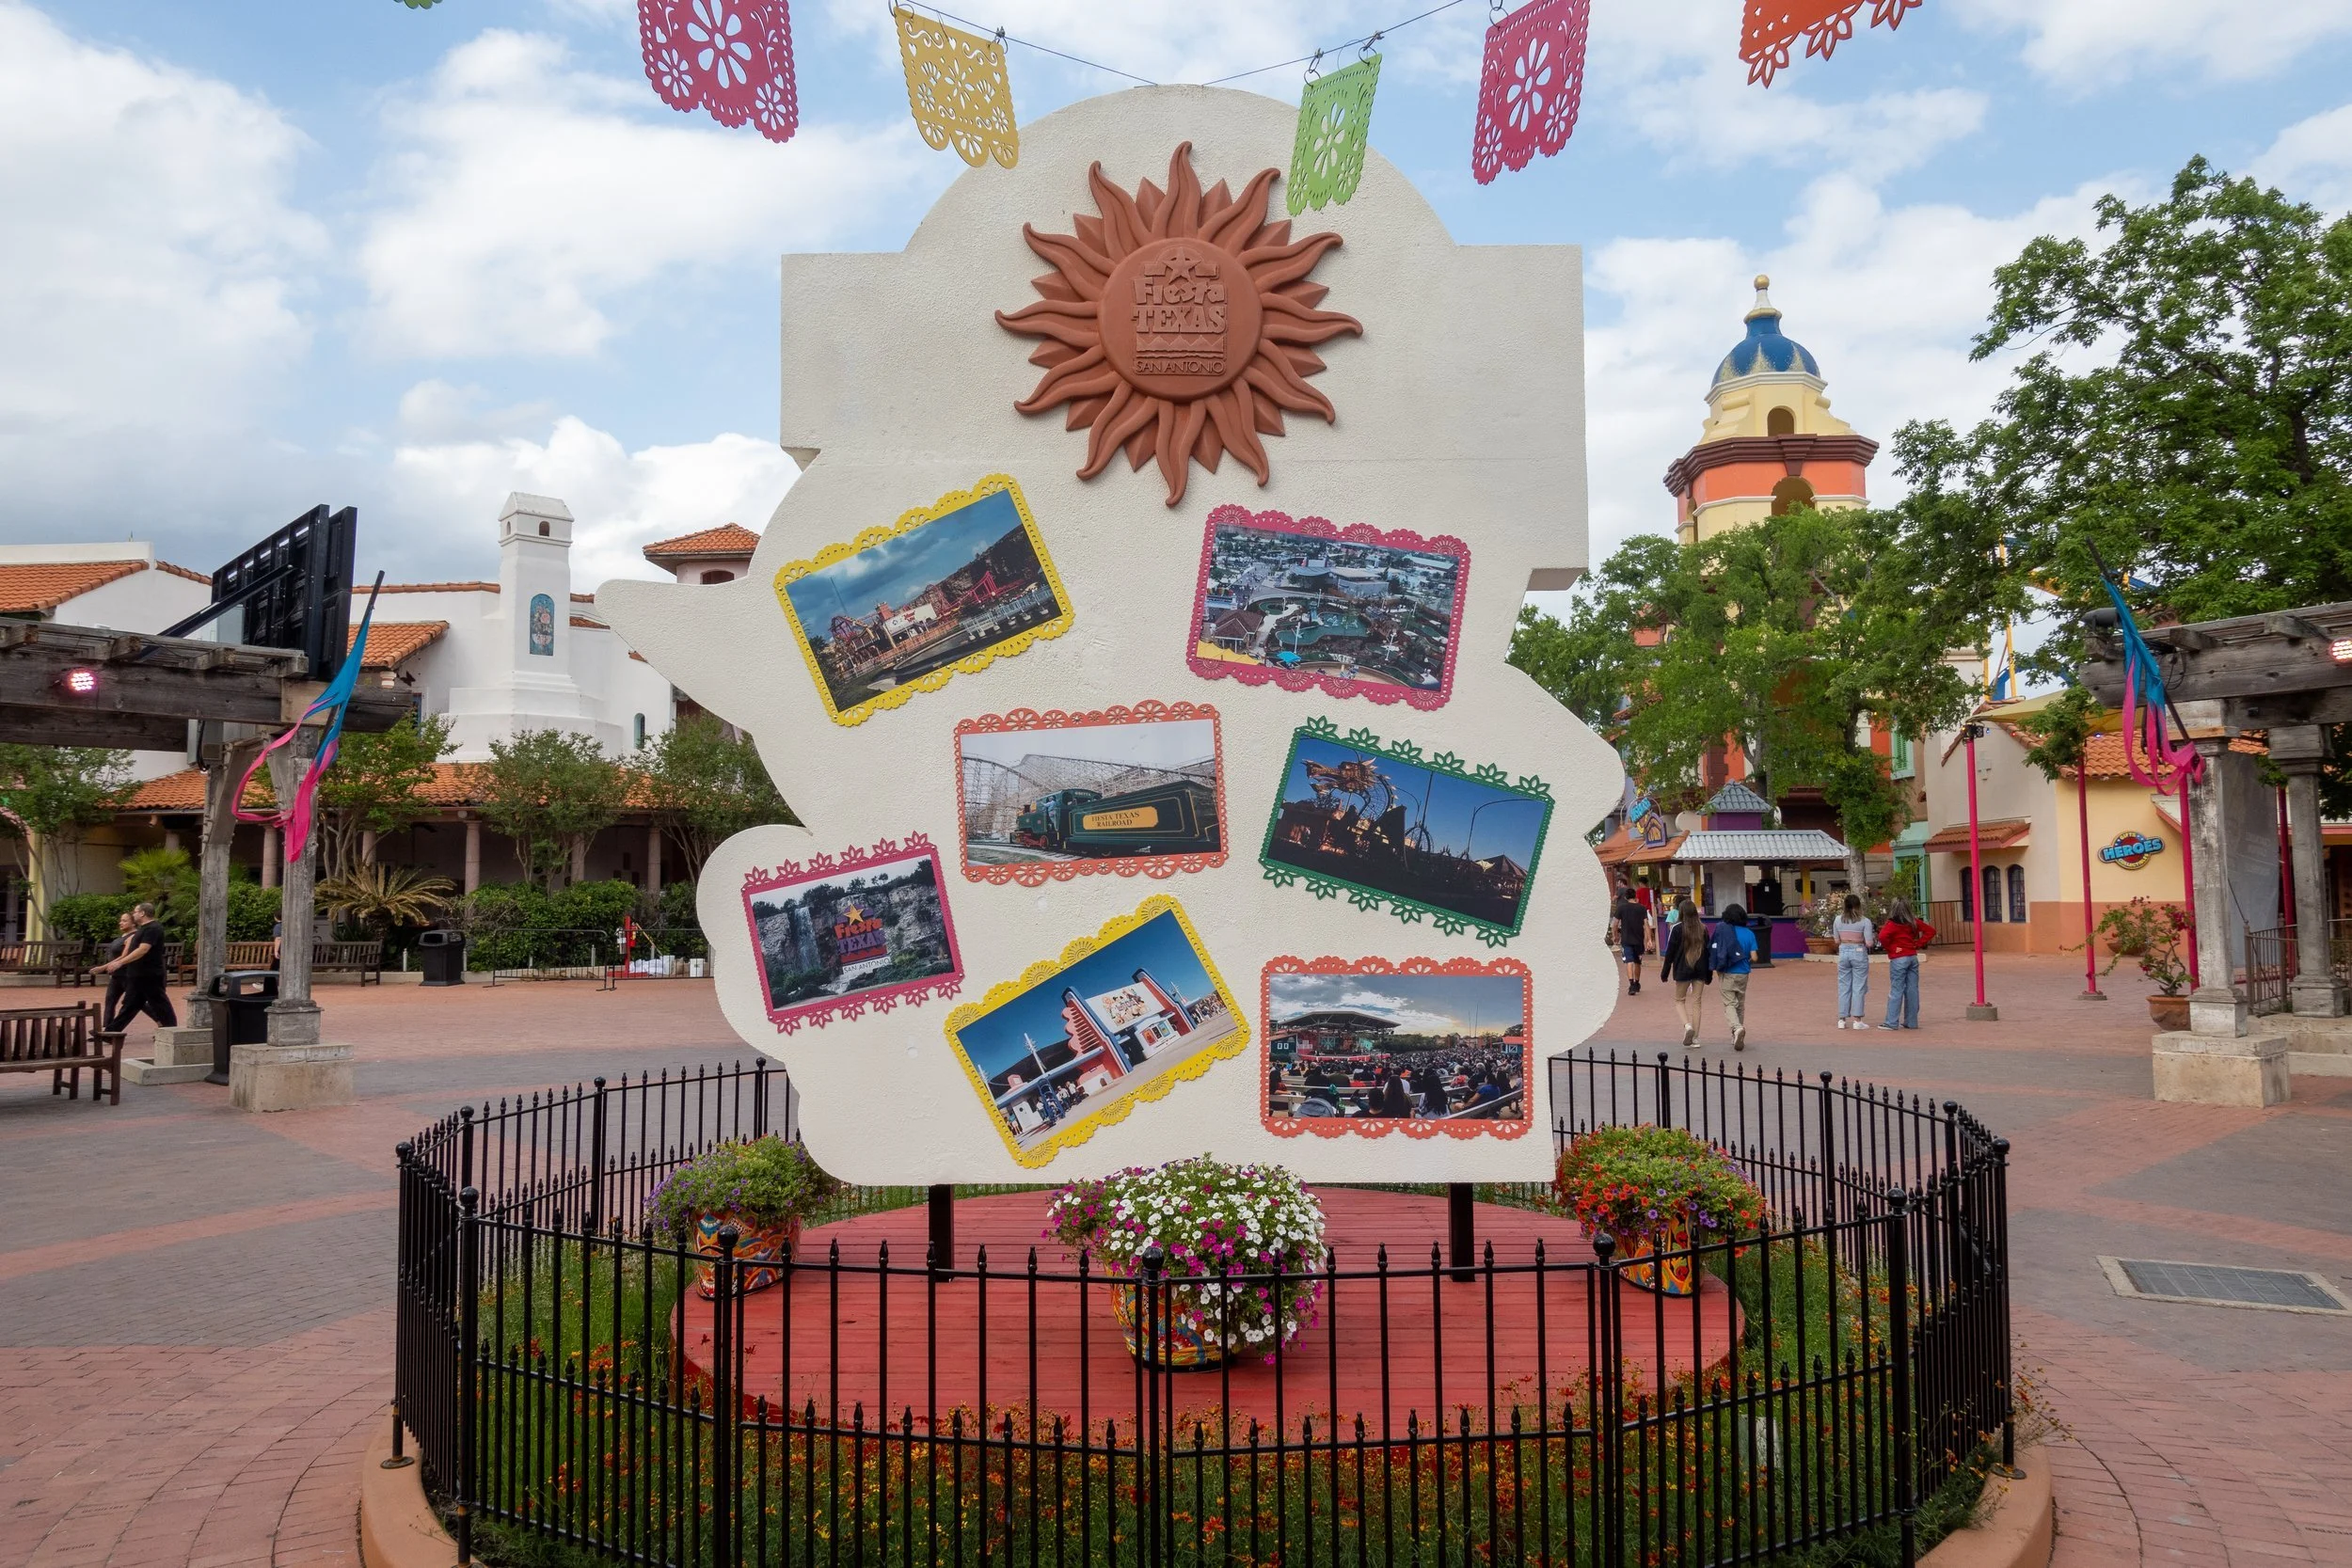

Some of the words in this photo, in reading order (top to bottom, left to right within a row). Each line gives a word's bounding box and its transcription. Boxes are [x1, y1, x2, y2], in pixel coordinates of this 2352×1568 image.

[1134, 277, 1225, 305] Fiesta
[1133, 306, 1226, 334] TEXAS
[1136, 361, 1163, 373] SAN
[1165, 361, 1224, 373] ANTONIO
[1091, 814, 1113, 822] FIESTA
[1115, 810, 1140, 819] TEXAS
[1096, 819, 1133, 828] RAILROAD
[2103, 839, 2162, 860] HEROES
[834, 918, 882, 940] Fiesta
[837, 929, 885, 954] TEXAS
[858, 958, 890, 970] ANTONIO
